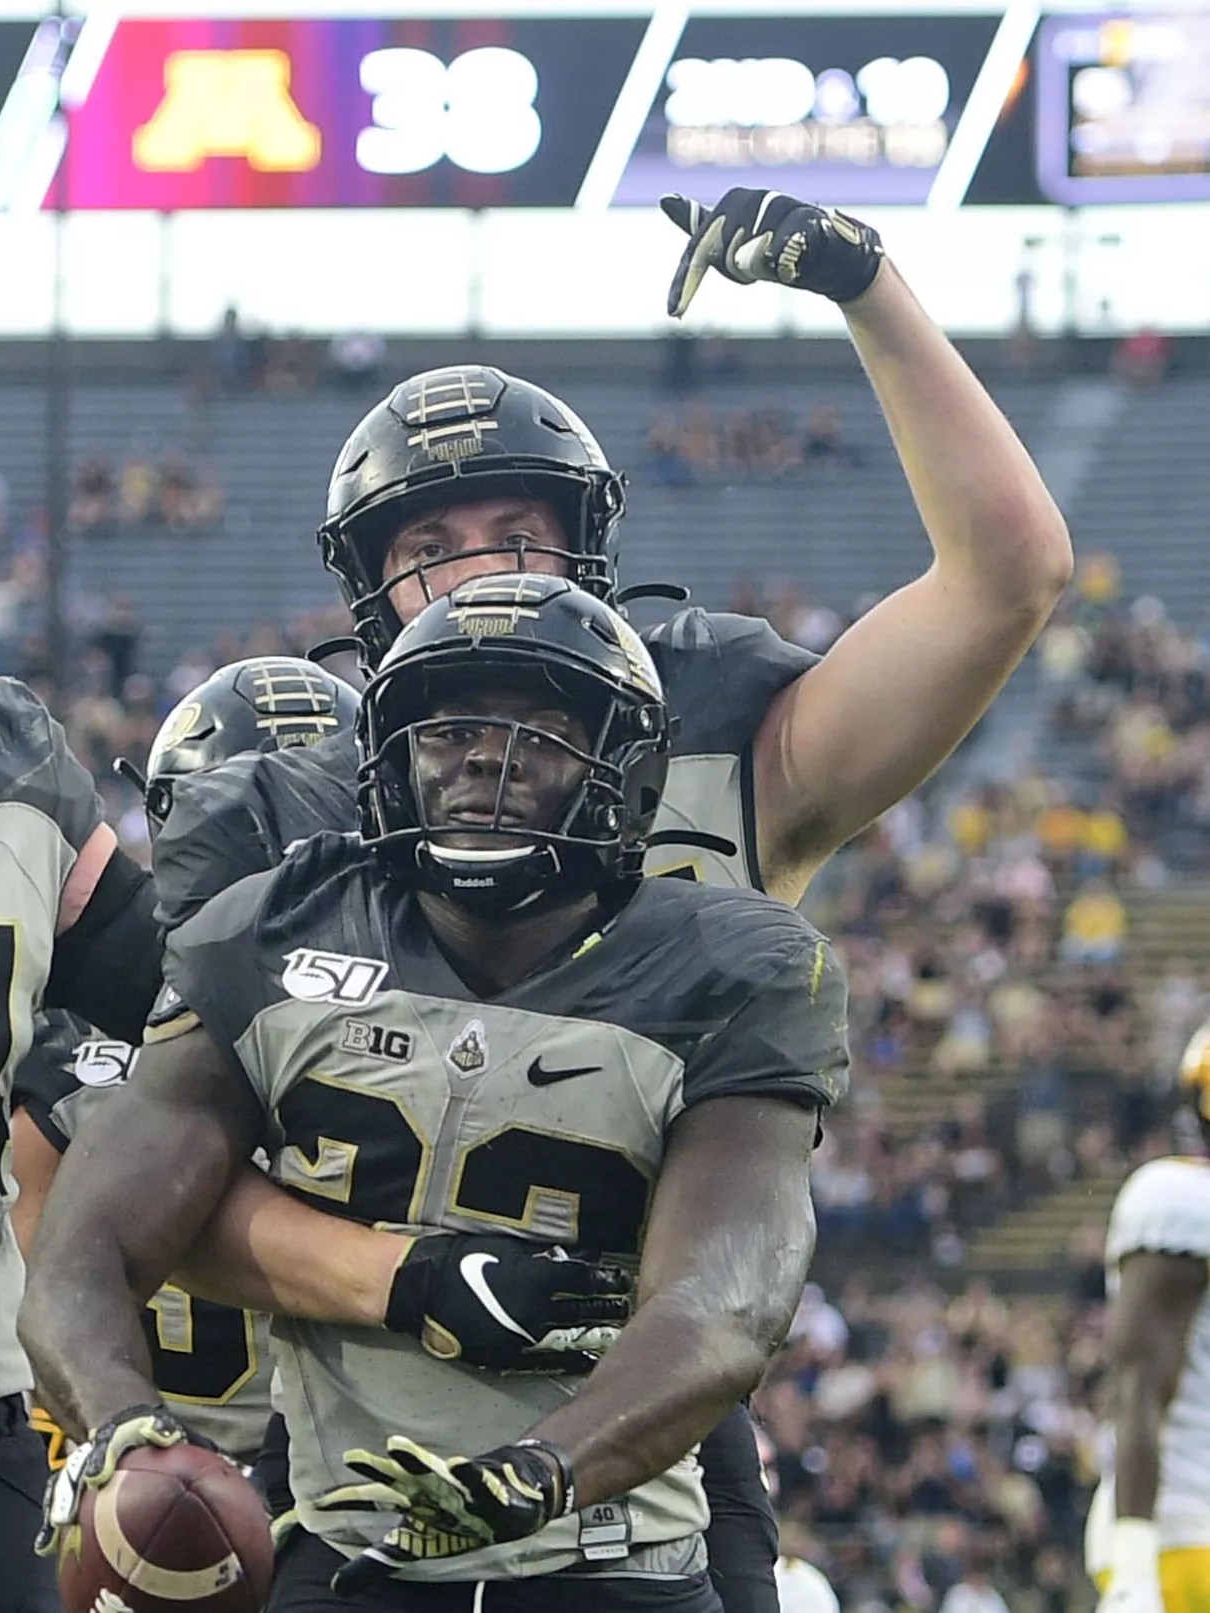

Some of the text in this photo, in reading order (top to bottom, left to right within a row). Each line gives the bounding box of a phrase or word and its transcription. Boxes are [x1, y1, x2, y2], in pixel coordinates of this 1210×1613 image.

[356, 46, 542, 174] 38
[282, 947, 389, 1006] 150
[592, 1506, 615, 1522] 40
